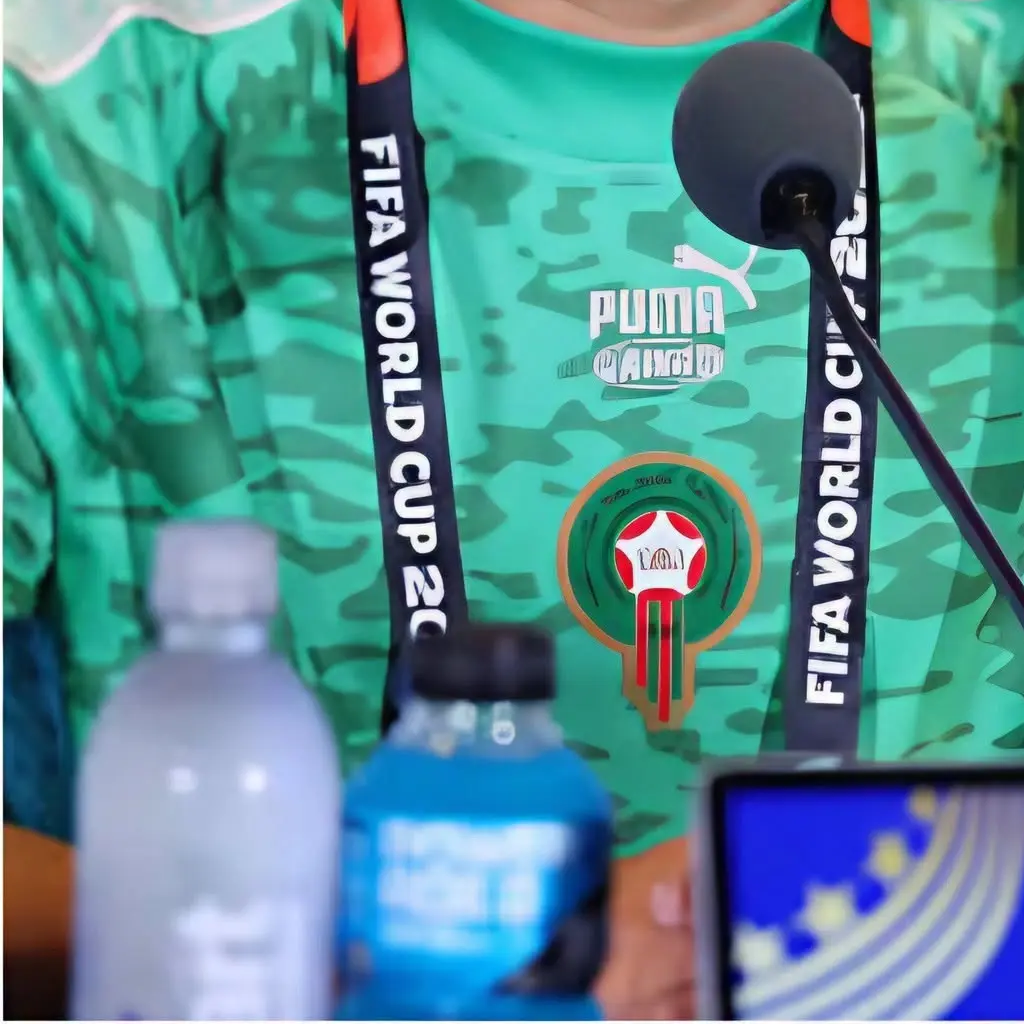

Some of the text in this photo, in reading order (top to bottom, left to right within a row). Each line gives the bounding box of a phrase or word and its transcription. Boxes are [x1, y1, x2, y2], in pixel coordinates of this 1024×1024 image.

[360, 134, 405, 249] FIFA
[369, 251, 426, 443] WORLD
[589, 286, 726, 339] PUMA
[388, 452, 437, 555] CUP
[812, 394, 863, 591] WORLD
[805, 595, 850, 705] FIFA
